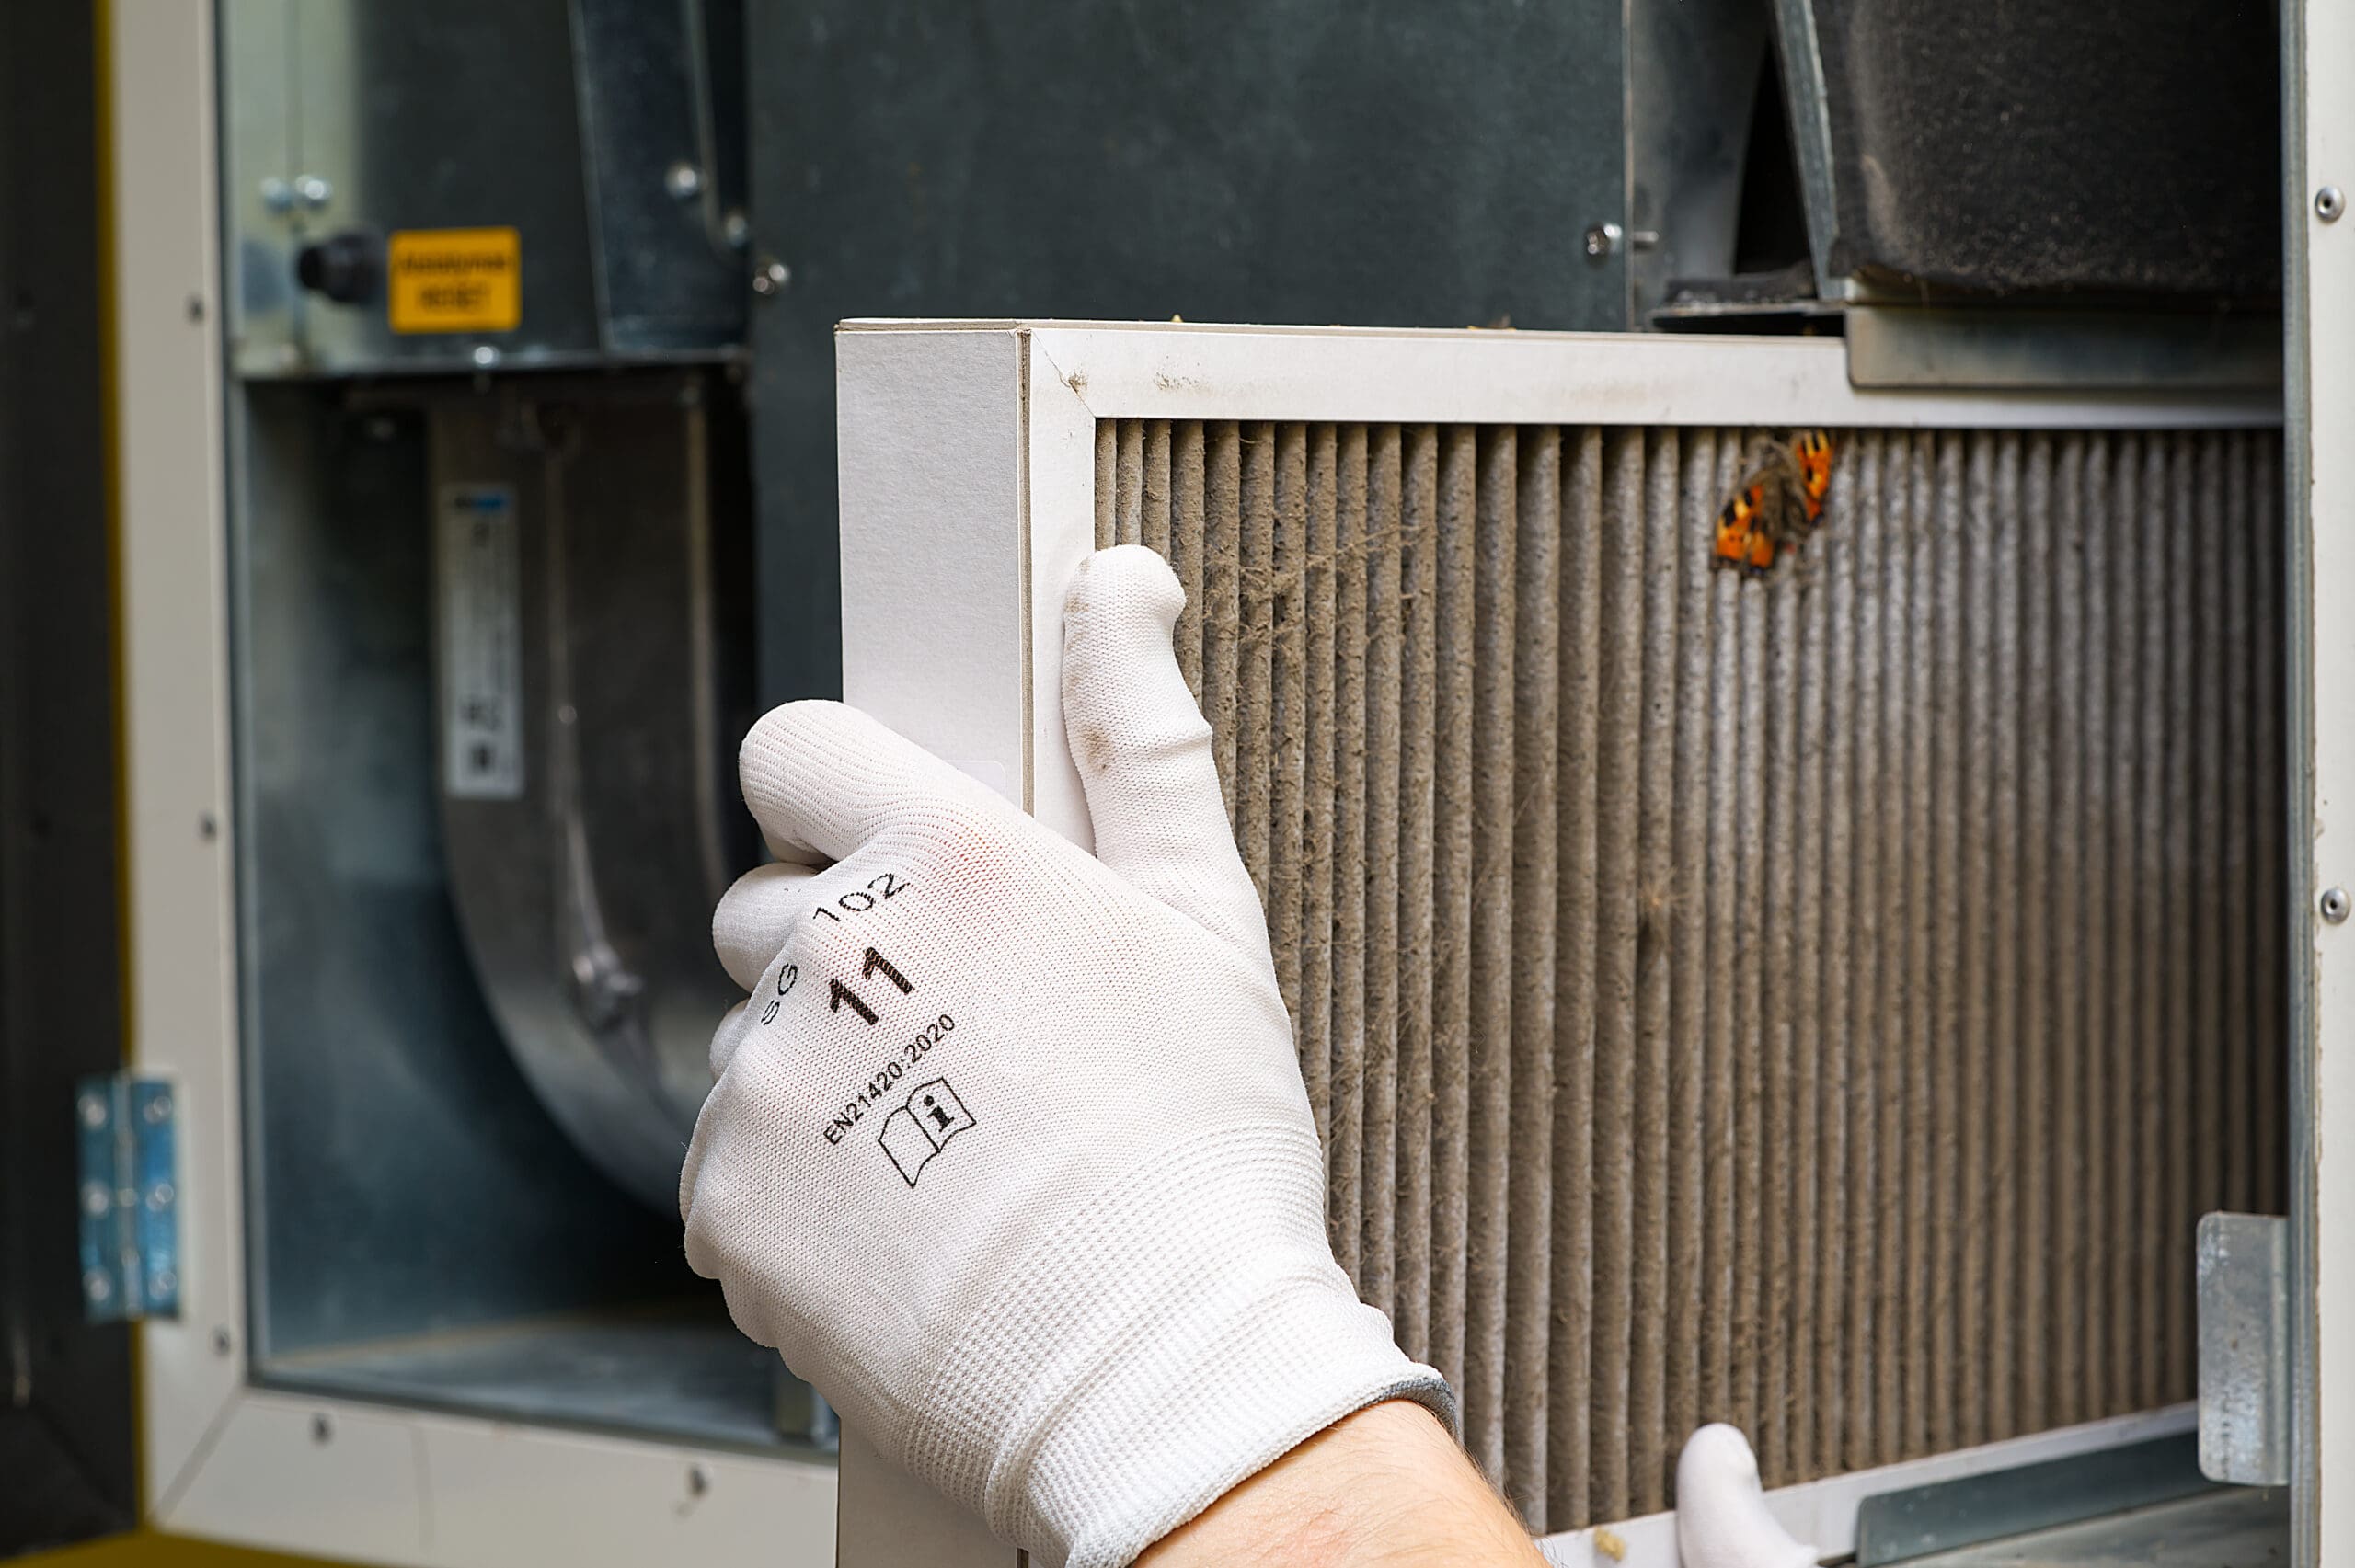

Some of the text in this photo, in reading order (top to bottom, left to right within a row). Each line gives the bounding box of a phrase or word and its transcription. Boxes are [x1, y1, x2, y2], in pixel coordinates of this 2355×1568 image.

[761, 873, 910, 1026] SG 102
[828, 946, 914, 1026] 11
[823, 1013, 956, 1146] EN21420:2020
